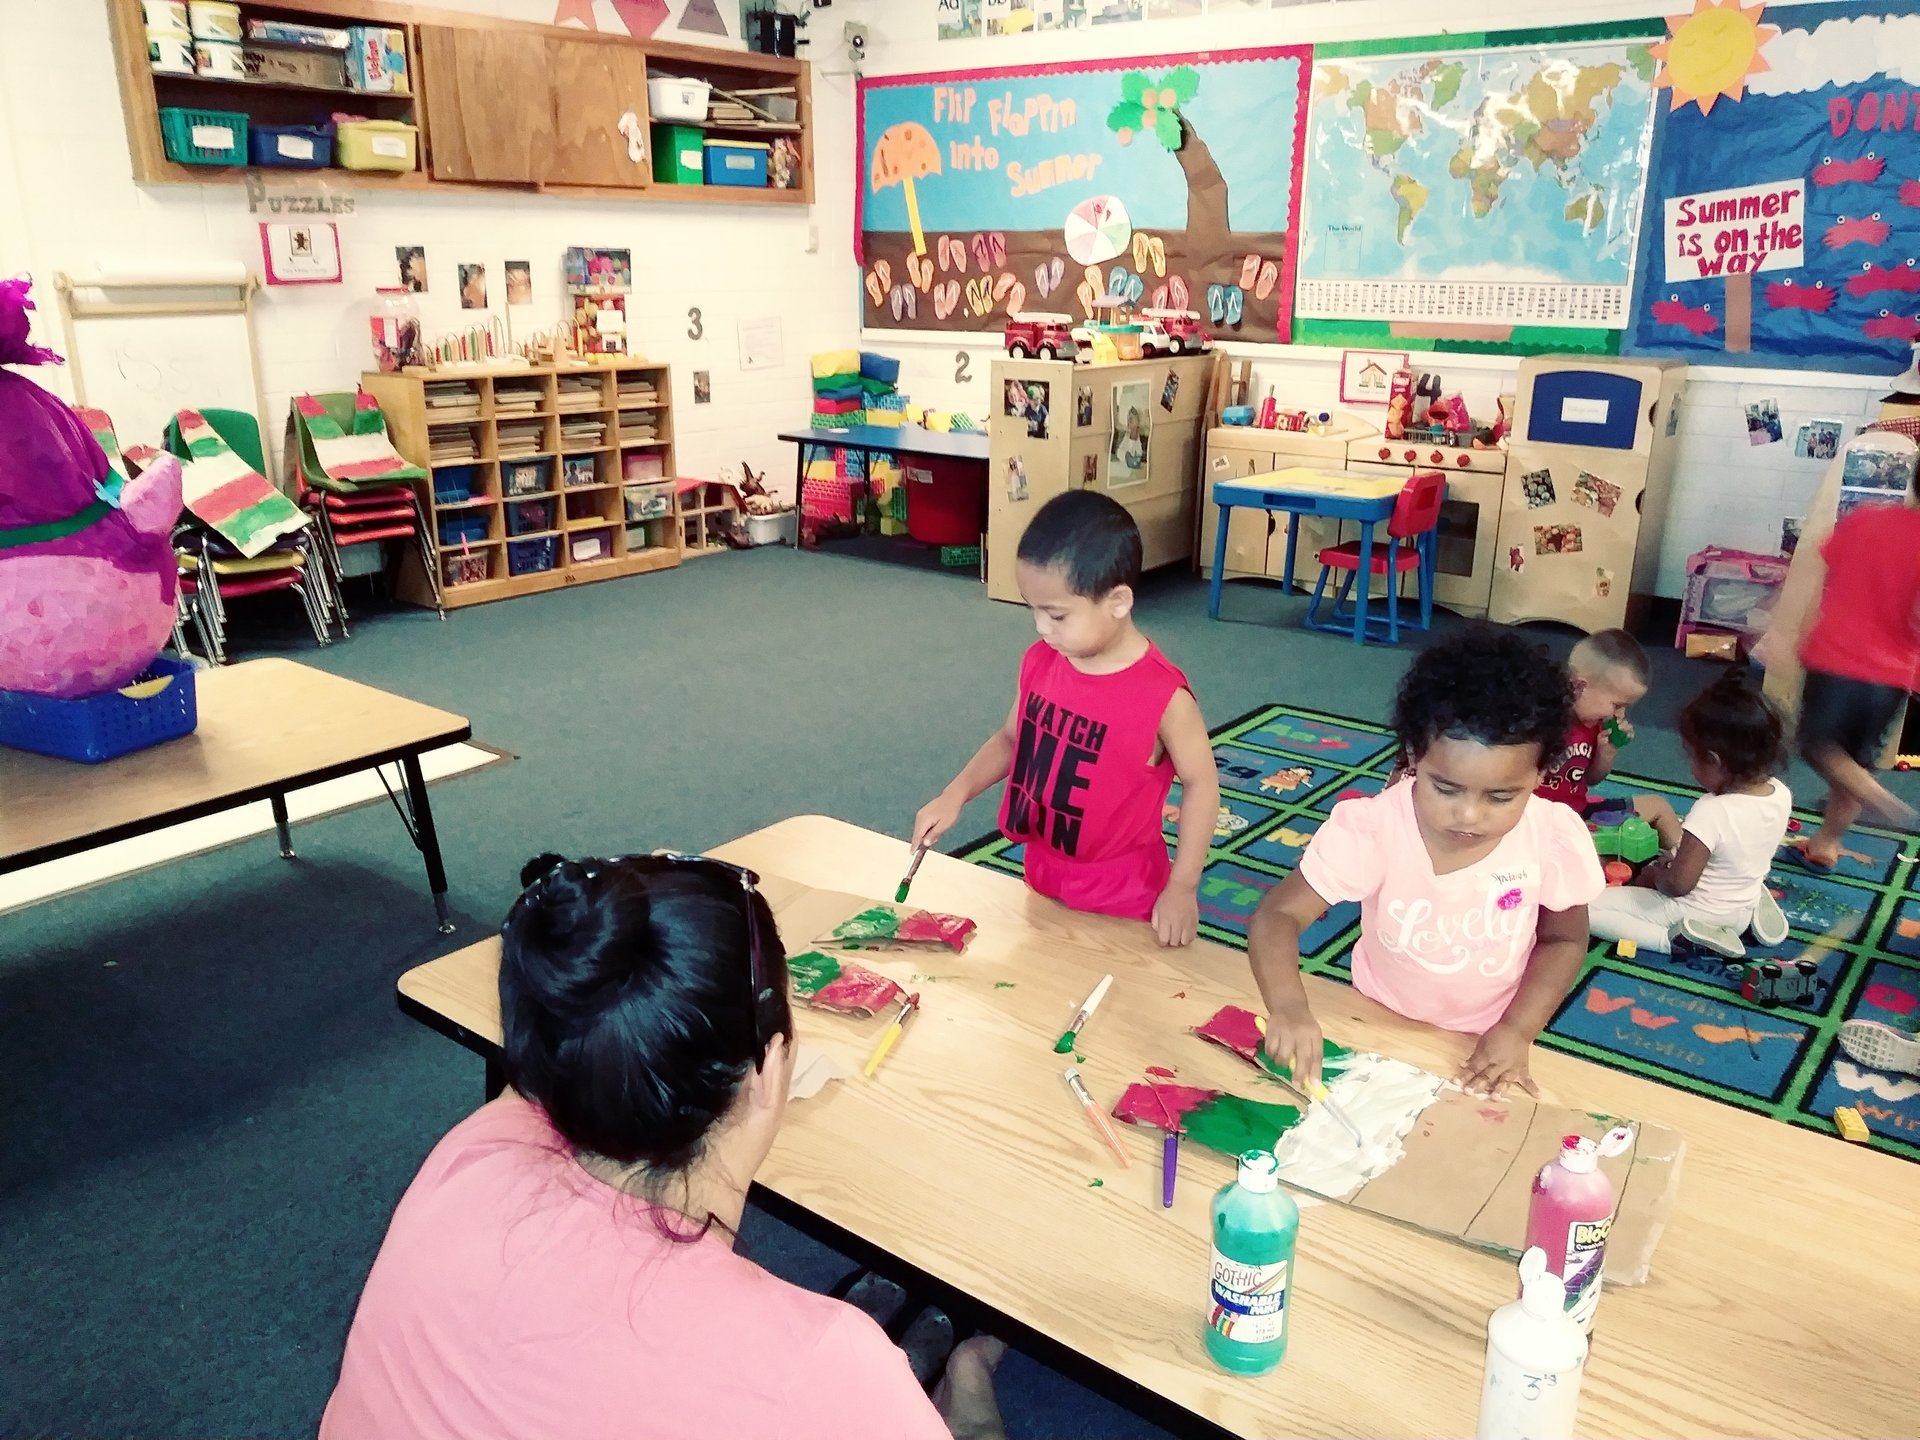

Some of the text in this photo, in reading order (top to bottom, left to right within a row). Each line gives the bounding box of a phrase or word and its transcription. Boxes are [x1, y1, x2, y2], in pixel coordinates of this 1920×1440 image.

[1007, 152, 1102, 198] Summer
[1675, 189, 1800, 227] Summer
[1677, 221, 1802, 257] is on the
[1697, 251, 1768, 277] way
[687, 306, 703, 341] 3
[955, 351, 973, 384] 2
[1025, 691, 1108, 751] WATCH
[1012, 718, 1099, 818] ME
[1005, 786, 1082, 857] WIN
[1376, 883, 1532, 978] Lovely
[1214, 1261, 1262, 1288] GOTHIC
[1214, 1281, 1282, 1307] WASHABLE
[1249, 1301, 1281, 1315] PAINT
